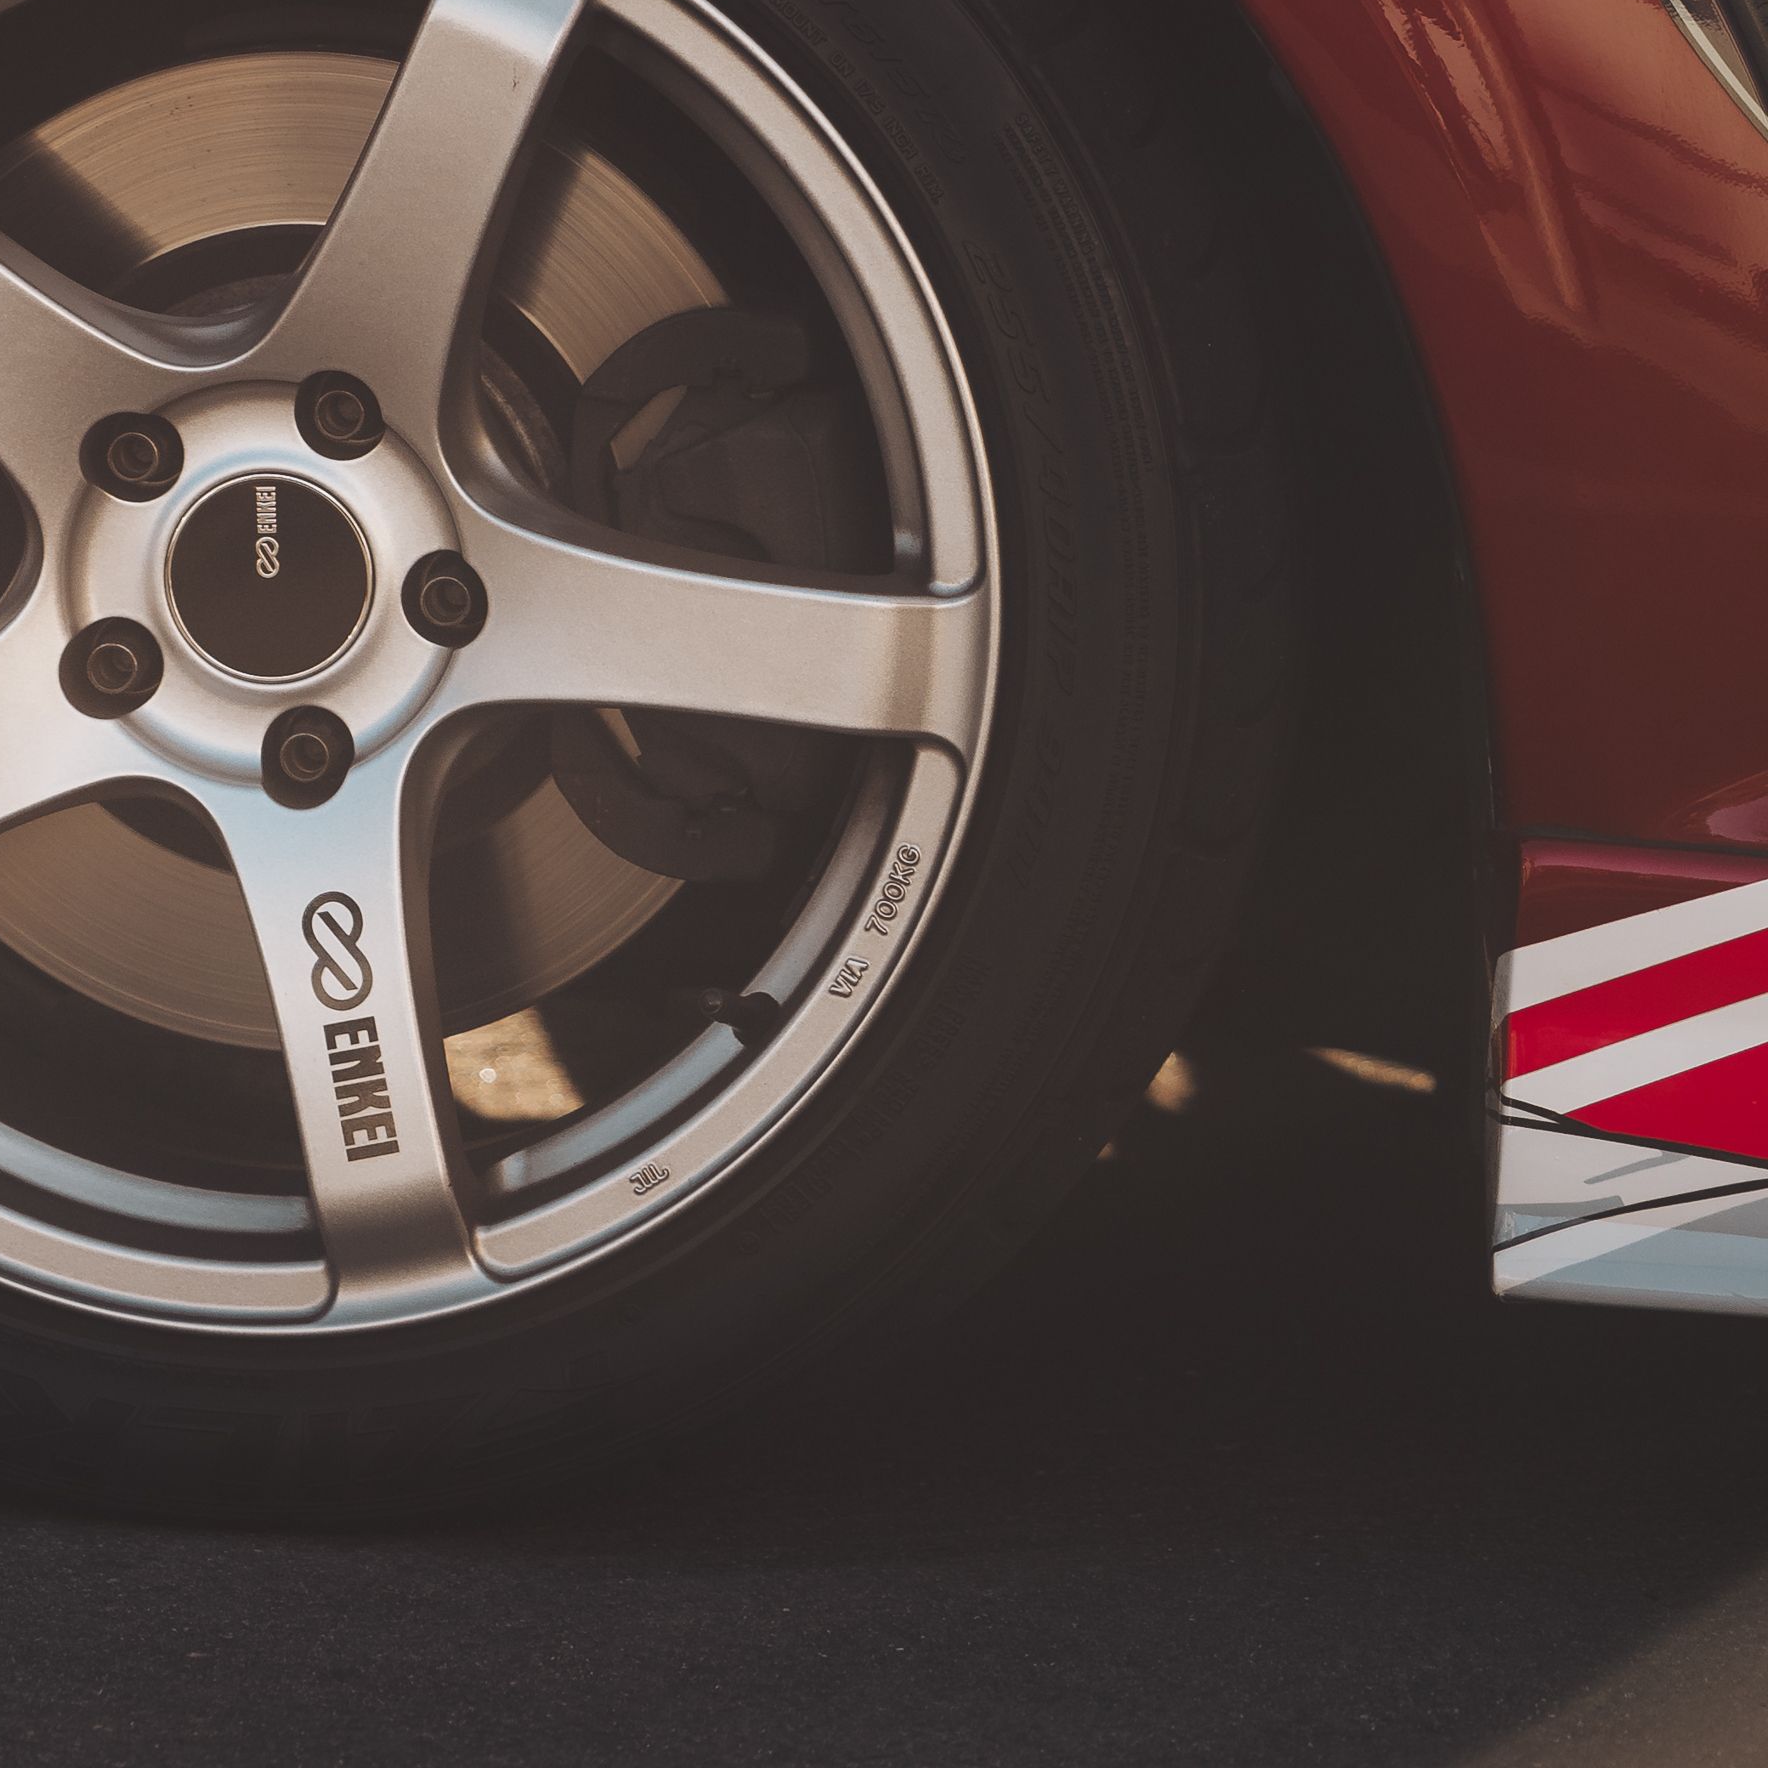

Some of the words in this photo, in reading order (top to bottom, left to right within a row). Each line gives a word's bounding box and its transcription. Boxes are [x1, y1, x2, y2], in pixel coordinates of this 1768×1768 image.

[255, 486, 277, 534] ENKEI
[829, 957, 869, 999] VIA
[864, 843, 921, 936] 700KG
[323, 1016, 400, 1162] ENKEI
